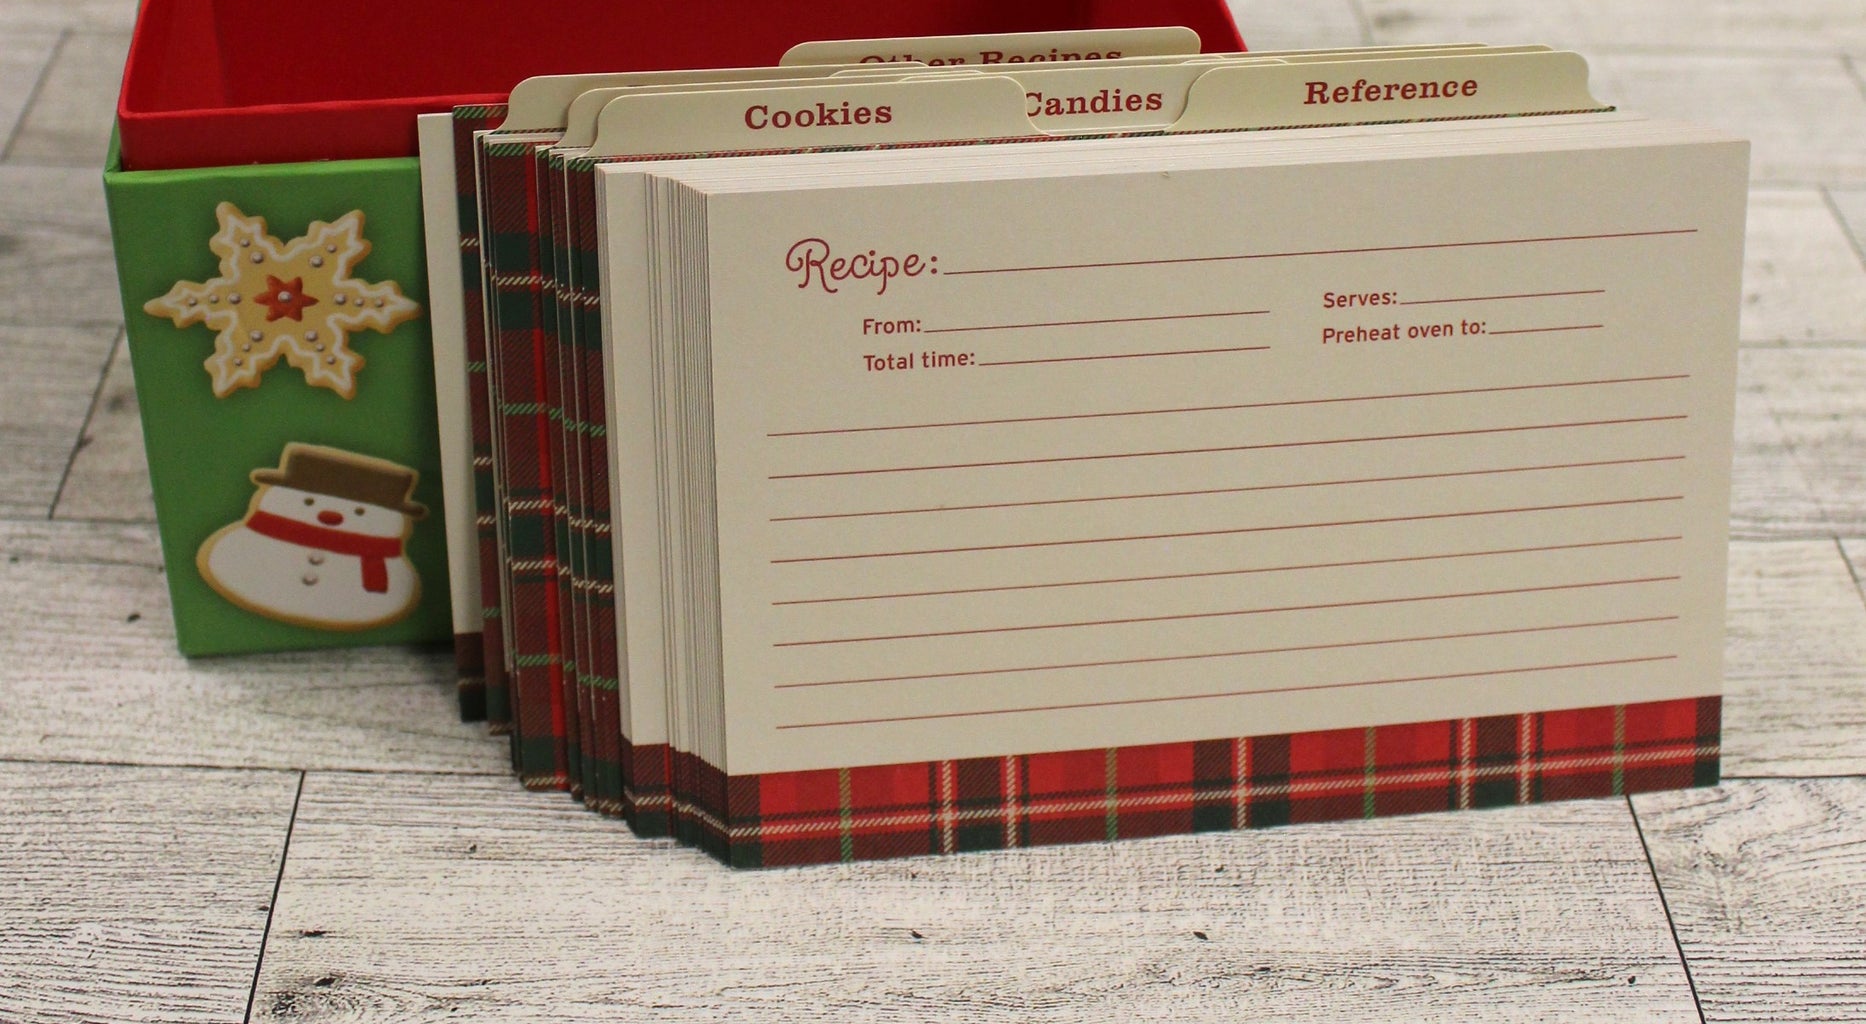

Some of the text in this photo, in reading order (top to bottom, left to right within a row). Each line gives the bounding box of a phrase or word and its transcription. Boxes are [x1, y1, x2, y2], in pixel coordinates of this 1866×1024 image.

[1026, 88, 1163, 117] Candies
[1303, 79, 1478, 105] Reference
[744, 101, 893, 130] Cookies
[785, 238, 938, 295] Recipe:
[1323, 291, 1397, 309] Serves:
[862, 318, 921, 335] From:
[1322, 319, 1486, 344] Preheat oven to:
[863, 351, 975, 372] Total time:
